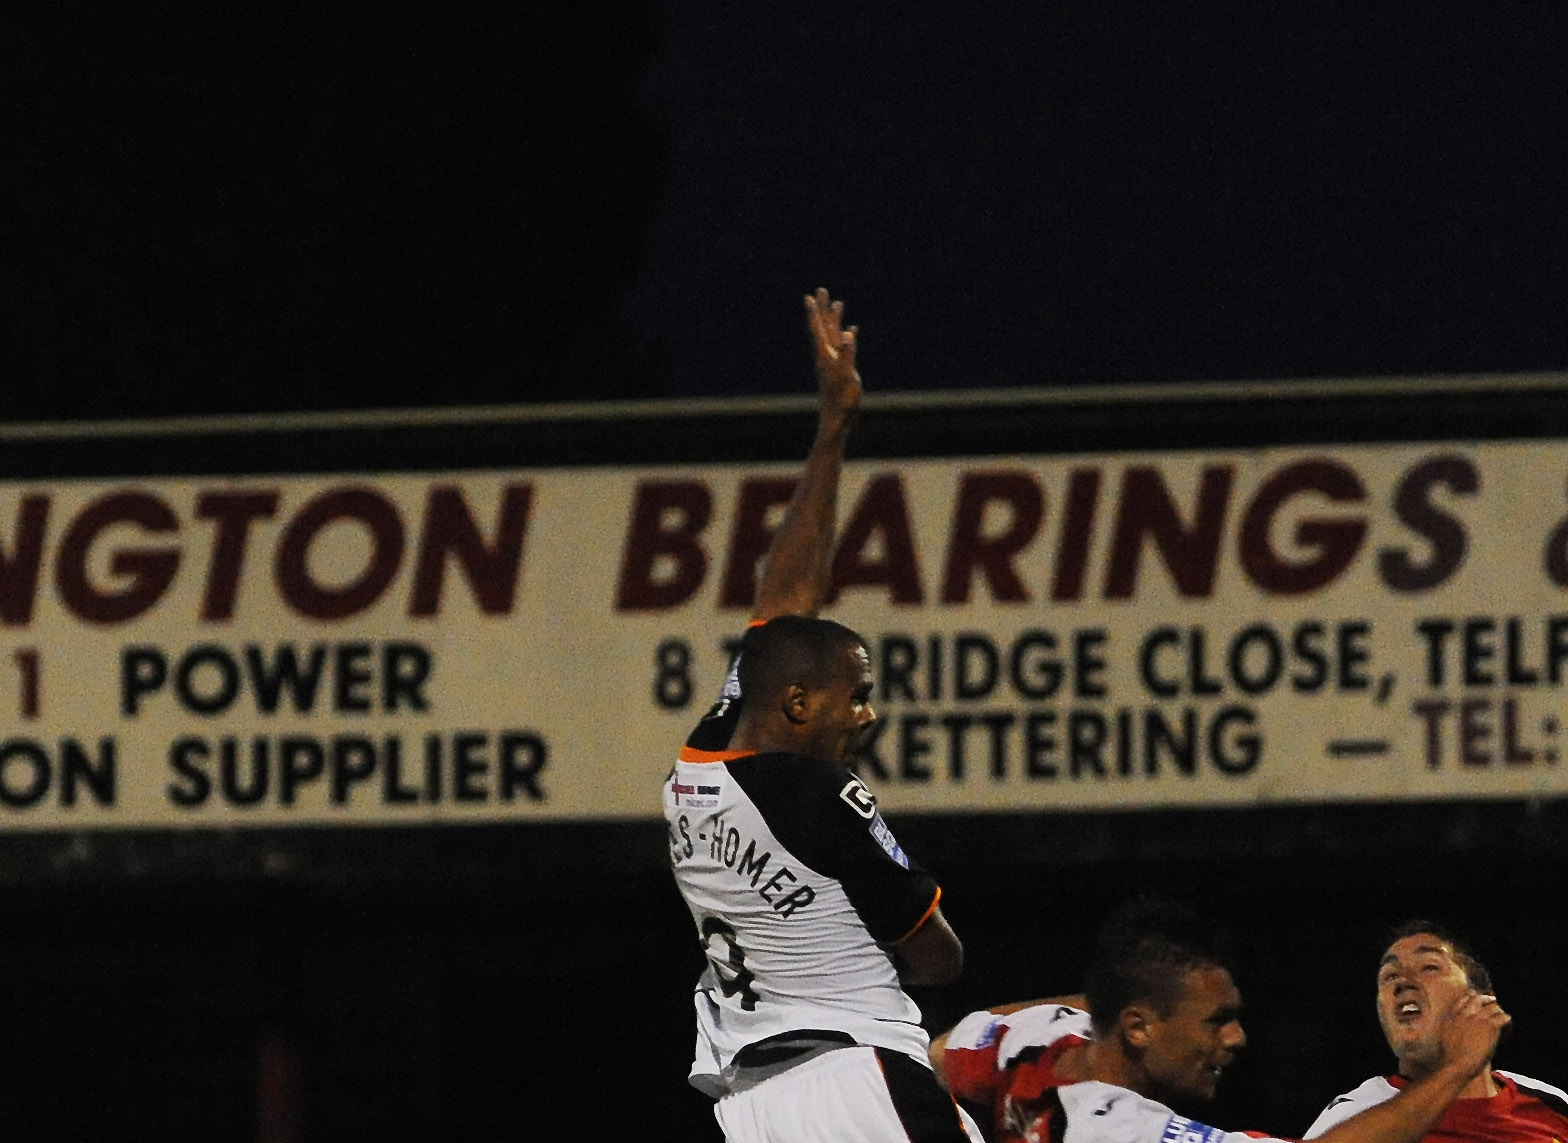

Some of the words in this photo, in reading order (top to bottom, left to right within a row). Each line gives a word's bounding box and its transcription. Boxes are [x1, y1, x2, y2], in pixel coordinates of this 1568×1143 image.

[614, 454, 1481, 611] BEARINGS
[14, 646, 41, 719] 1
[122, 640, 431, 716] POWER
[655, 637, 693, 709] 8
[1139, 620, 1394, 704] CLOSE,
[0, 737, 115, 809] ON
[168, 731, 548, 806] SUPPLIER
[855, 705, 1264, 783] KETTERING
[1413, 698, 1560, 770] TEL:
